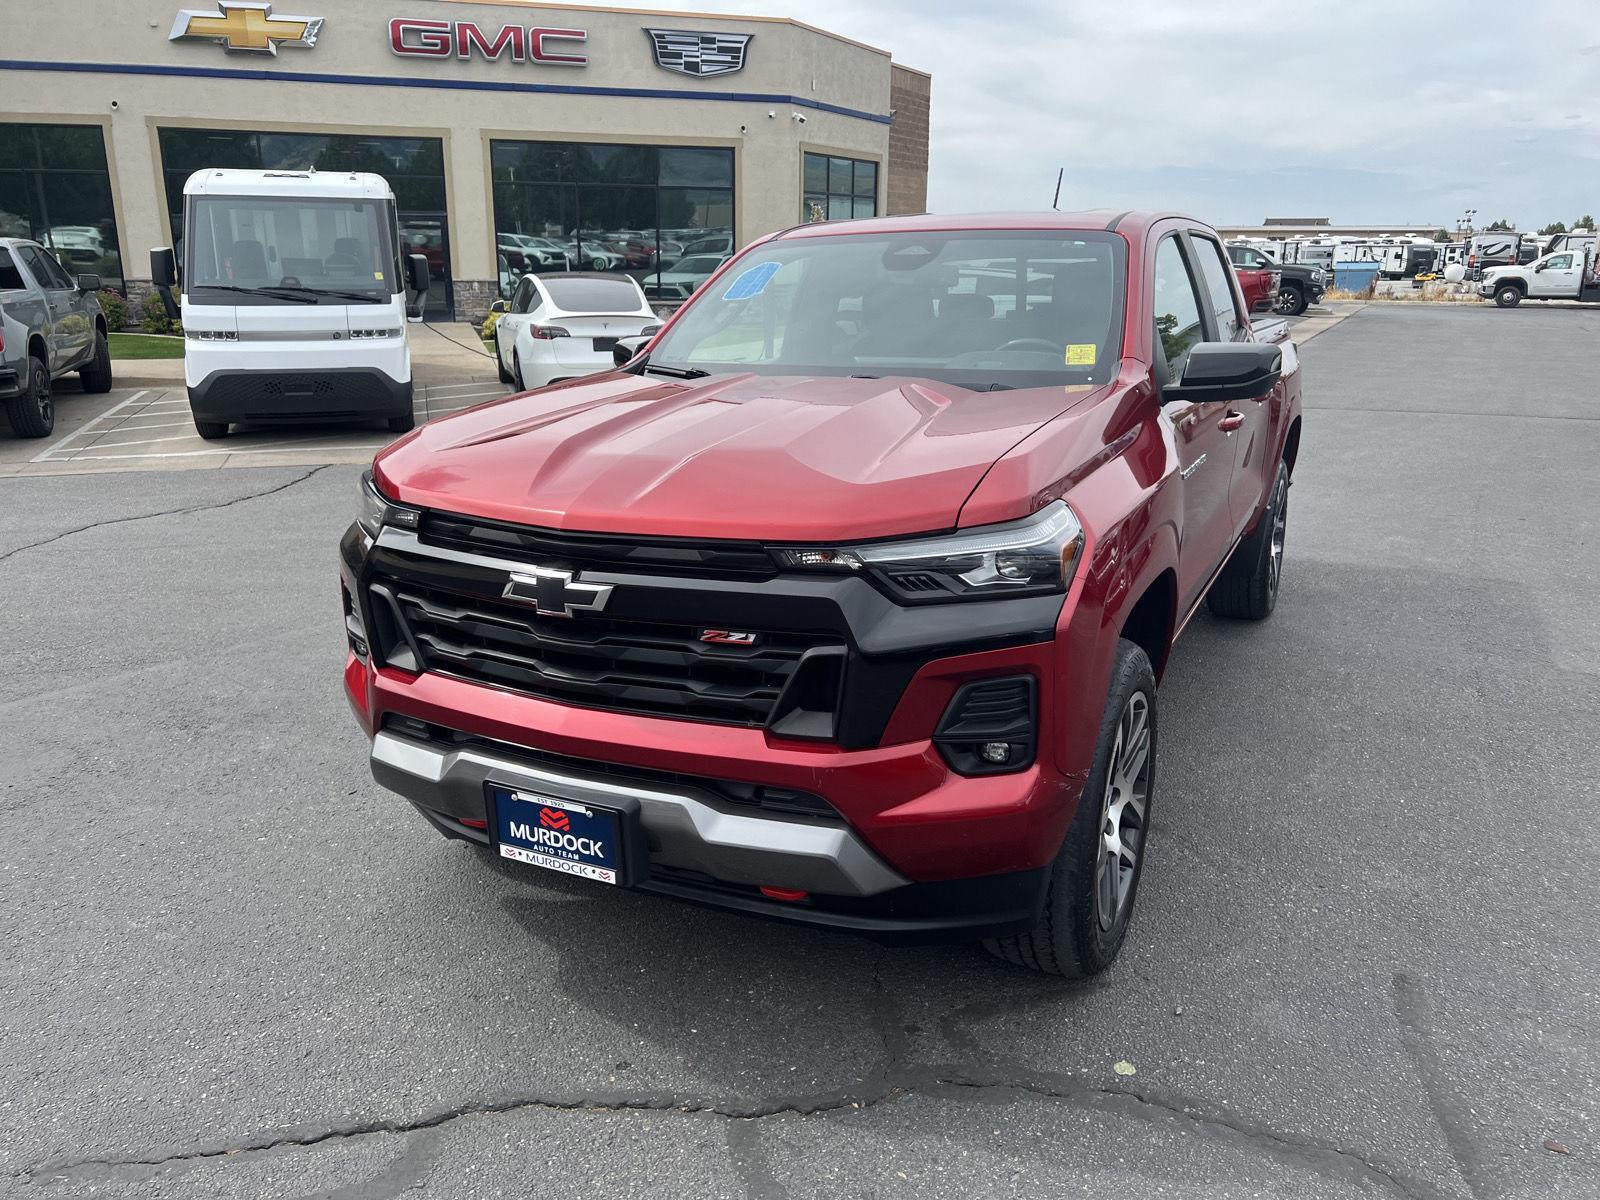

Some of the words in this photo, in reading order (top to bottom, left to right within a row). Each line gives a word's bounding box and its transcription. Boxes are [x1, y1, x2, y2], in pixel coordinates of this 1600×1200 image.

[388, 17, 588, 67] GMC
[700, 629, 757, 645] Z71
[510, 821, 604, 858] MURDOCK
[526, 852, 588, 876] MURDOCK
[533, 844, 555, 855] AUTO
[558, 850, 579, 860] TEAM
